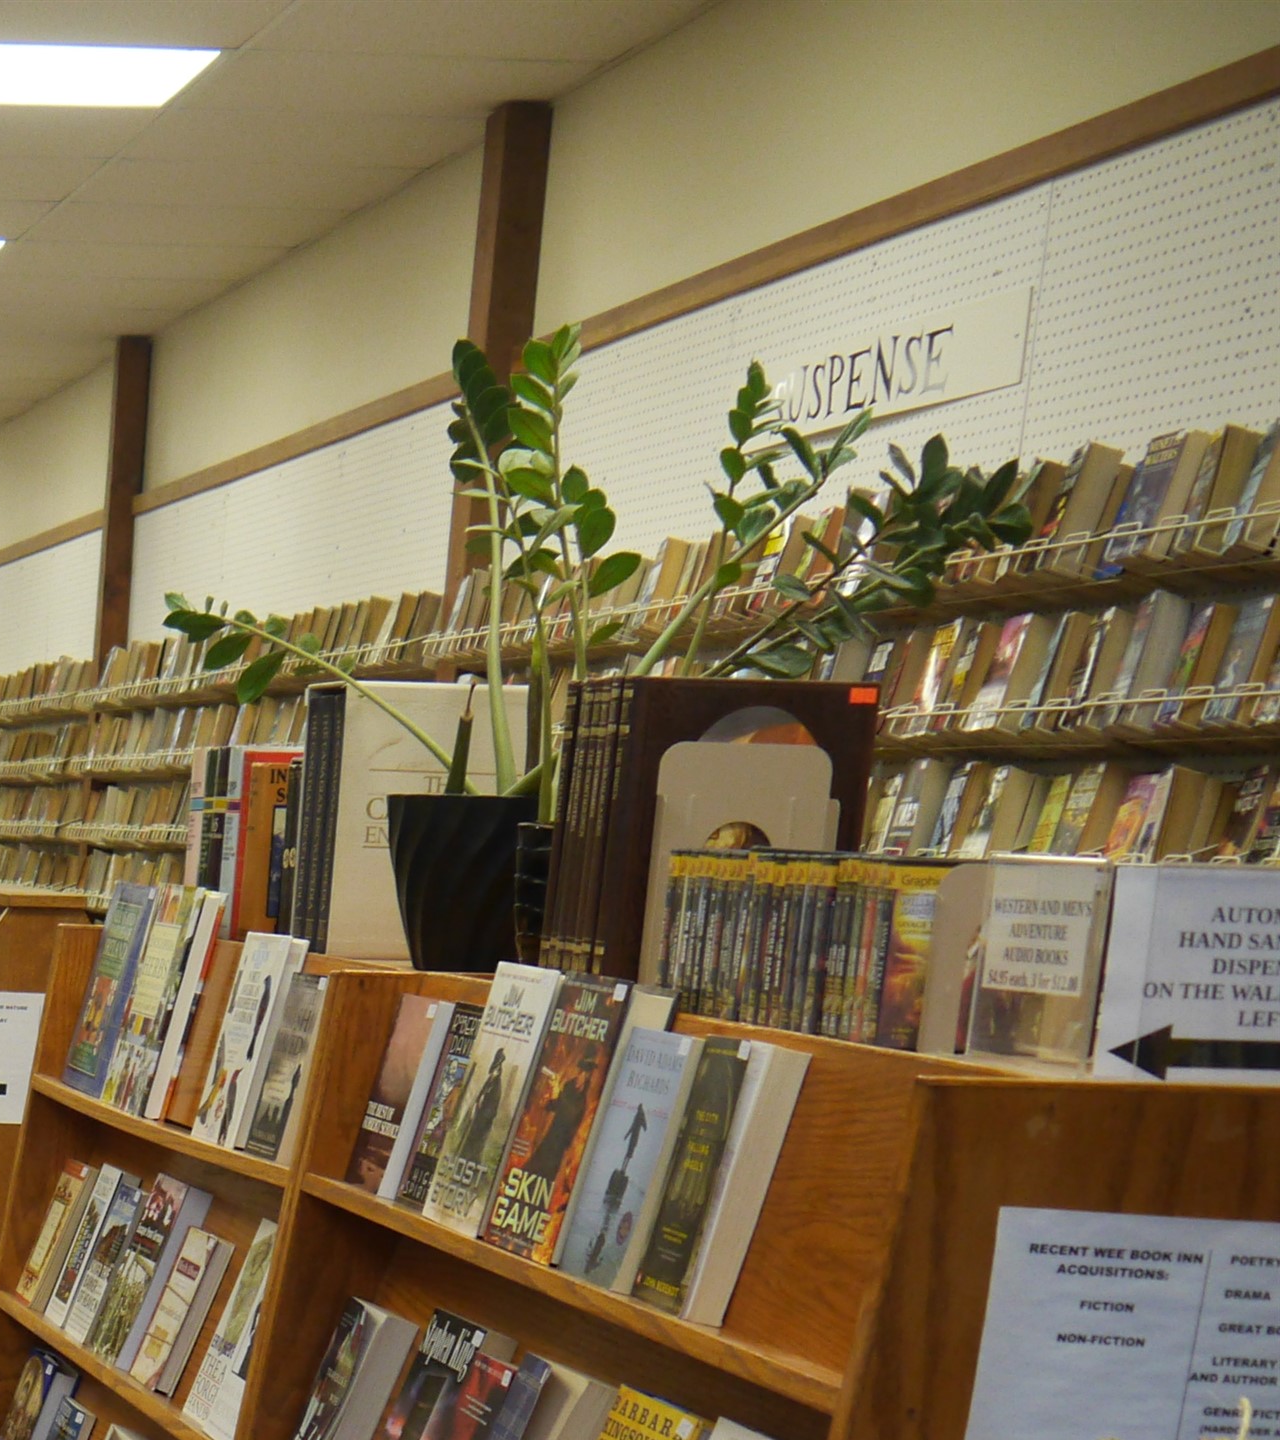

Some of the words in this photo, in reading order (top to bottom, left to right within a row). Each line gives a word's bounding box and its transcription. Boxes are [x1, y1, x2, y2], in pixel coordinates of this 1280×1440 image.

[770, 323, 954, 432] SUSPENSE
[1040, 900, 1061, 915] AND
[1009, 923, 1069, 941] ADVENTURE
[1179, 931, 1243, 949] HAND
[1002, 946, 1033, 963] AUDIO
[1033, 948, 1069, 965] BOOKS
[1143, 982, 1175, 998] ON
[1179, 983, 1225, 1000] THE
[574, 989, 598, 1014] JIM
[484, 1005, 536, 1036] BUTCHER
[550, 1008, 609, 1042] BUTCHER
[1237, 1010, 1280, 1027] LEF
[438, 1154, 488, 1188] GHOST
[503, 1168, 555, 1209] SKIN
[430, 1183, 478, 1218] STORY
[491, 1196, 552, 1240] GAME
[1029, 1242, 1089, 1257] RECENT
[1093, 1247, 1125, 1260] WEE
[1130, 1249, 1173, 1263] BOOK
[1177, 1252, 1204, 1264] INN
[1056, 1263, 1170, 1281] ACQUISITIONS:
[1224, 1288, 1271, 1301] DRAMA
[1079, 1300, 1136, 1313] FICTION
[1218, 1322, 1263, 1335] GREAT
[1266, 1325, 1280, 1336] BO
[419, 1314, 457, 1366] Stephen
[447, 1327, 475, 1383] King
[1056, 1333, 1146, 1347] NON-FICTION
[1212, 1356, 1279, 1369] LITERARY
[1190, 1372, 1219, 1384] AND
[1223, 1373, 1278, 1386] AUTHOR
[1203, 1406, 1244, 1418] GENR
[1252, 1409, 1280, 1420] FICT
[1199, 1425, 1266, 1437] (HARDCVER
